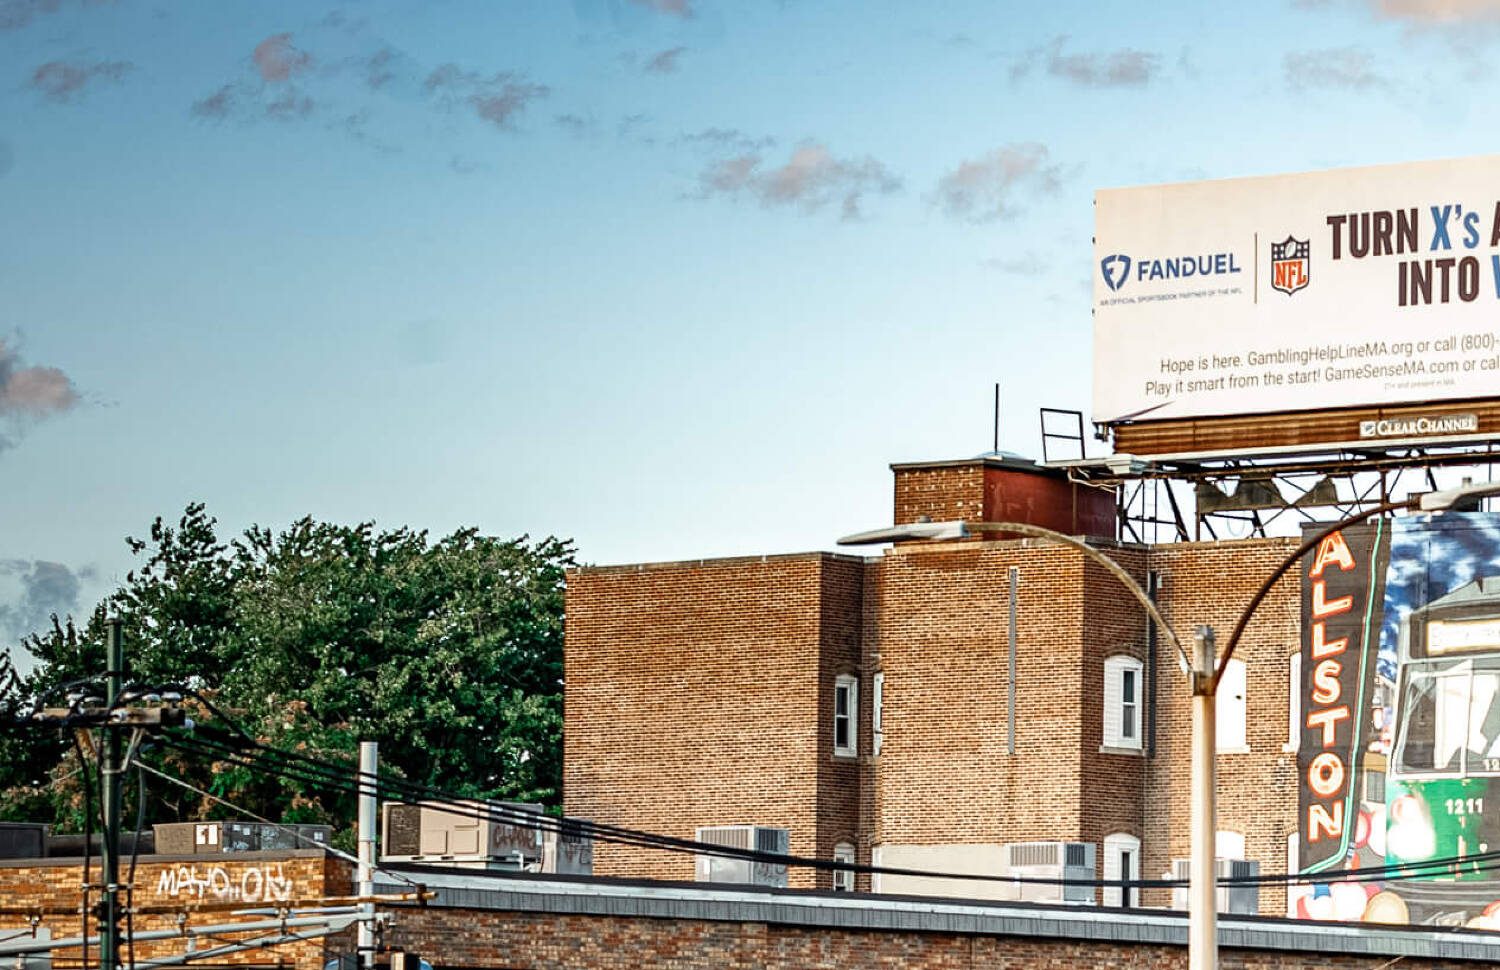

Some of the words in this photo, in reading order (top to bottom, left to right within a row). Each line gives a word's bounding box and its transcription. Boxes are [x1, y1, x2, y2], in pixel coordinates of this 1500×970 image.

[1326, 208, 1418, 260] TURN
[1430, 204, 1480, 251] X's
[1137, 253, 1241, 281] FANDUEL
[1275, 260, 1306, 289] NFL
[1398, 255, 1480, 307] INTO
[1160, 358, 1194, 374] Hope
[1198, 357, 1209, 371] is
[1212, 354, 1243, 370] here.
[1248, 342, 1413, 366] GamblingHelpLineMA.org
[1416, 341, 1430, 353] or
[1434, 334, 1456, 351] call
[1145, 381, 1171, 398] Play
[1175, 379, 1183, 392] it
[1187, 376, 1224, 392] smart
[1228, 373, 1259, 389] from
[1264, 371, 1283, 386] the
[1288, 368, 1321, 384] start!
[1325, 360, 1459, 383] GameSenseMA.com
[1463, 360, 1476, 372] or
[1307, 529, 1356, 842] ALLSTON
[1445, 798, 1483, 814] 1211
